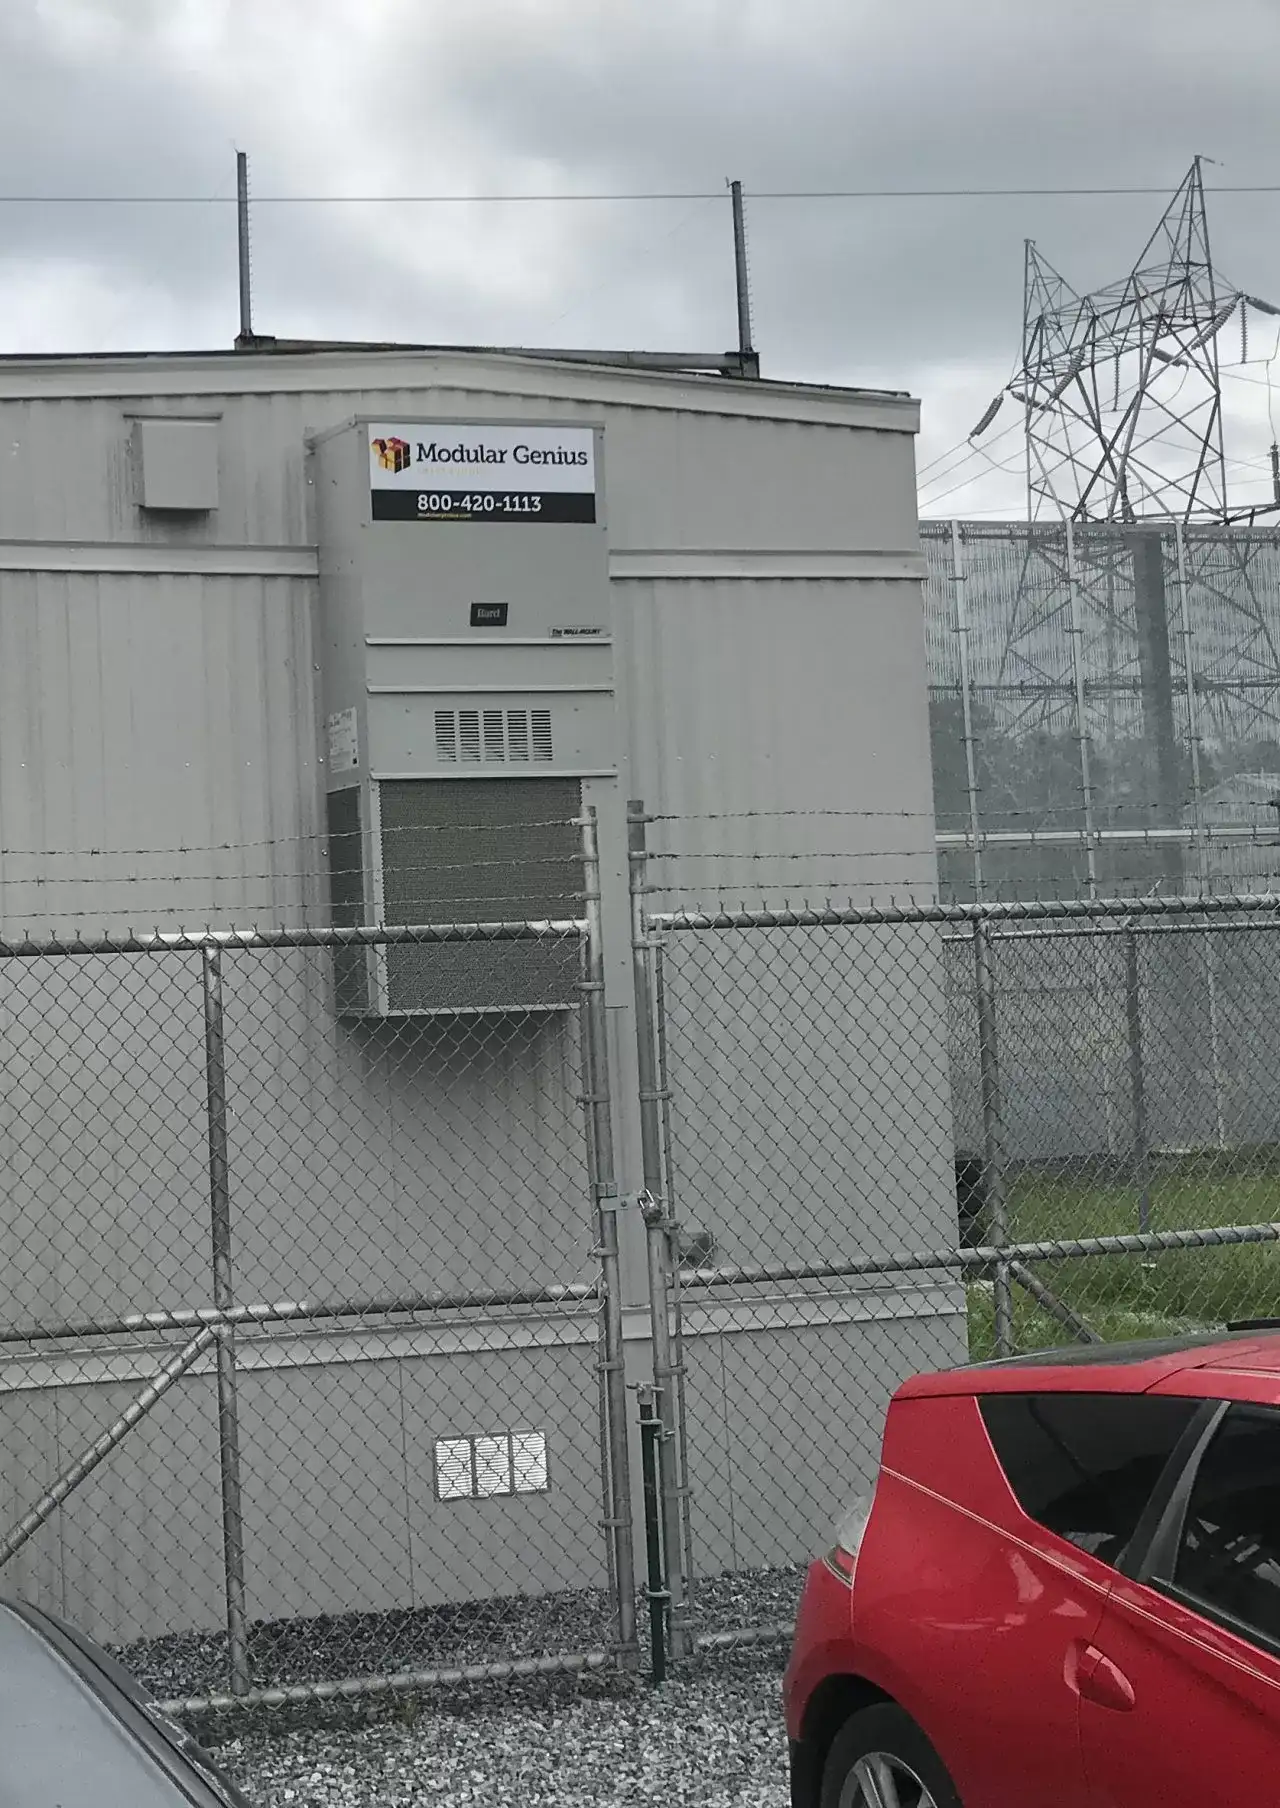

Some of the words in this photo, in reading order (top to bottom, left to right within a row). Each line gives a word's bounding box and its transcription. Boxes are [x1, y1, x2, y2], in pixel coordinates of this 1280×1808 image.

[416, 443, 507, 464] Modular
[513, 445, 588, 465] Genius
[417, 494, 542, 512] 800-420-1113
